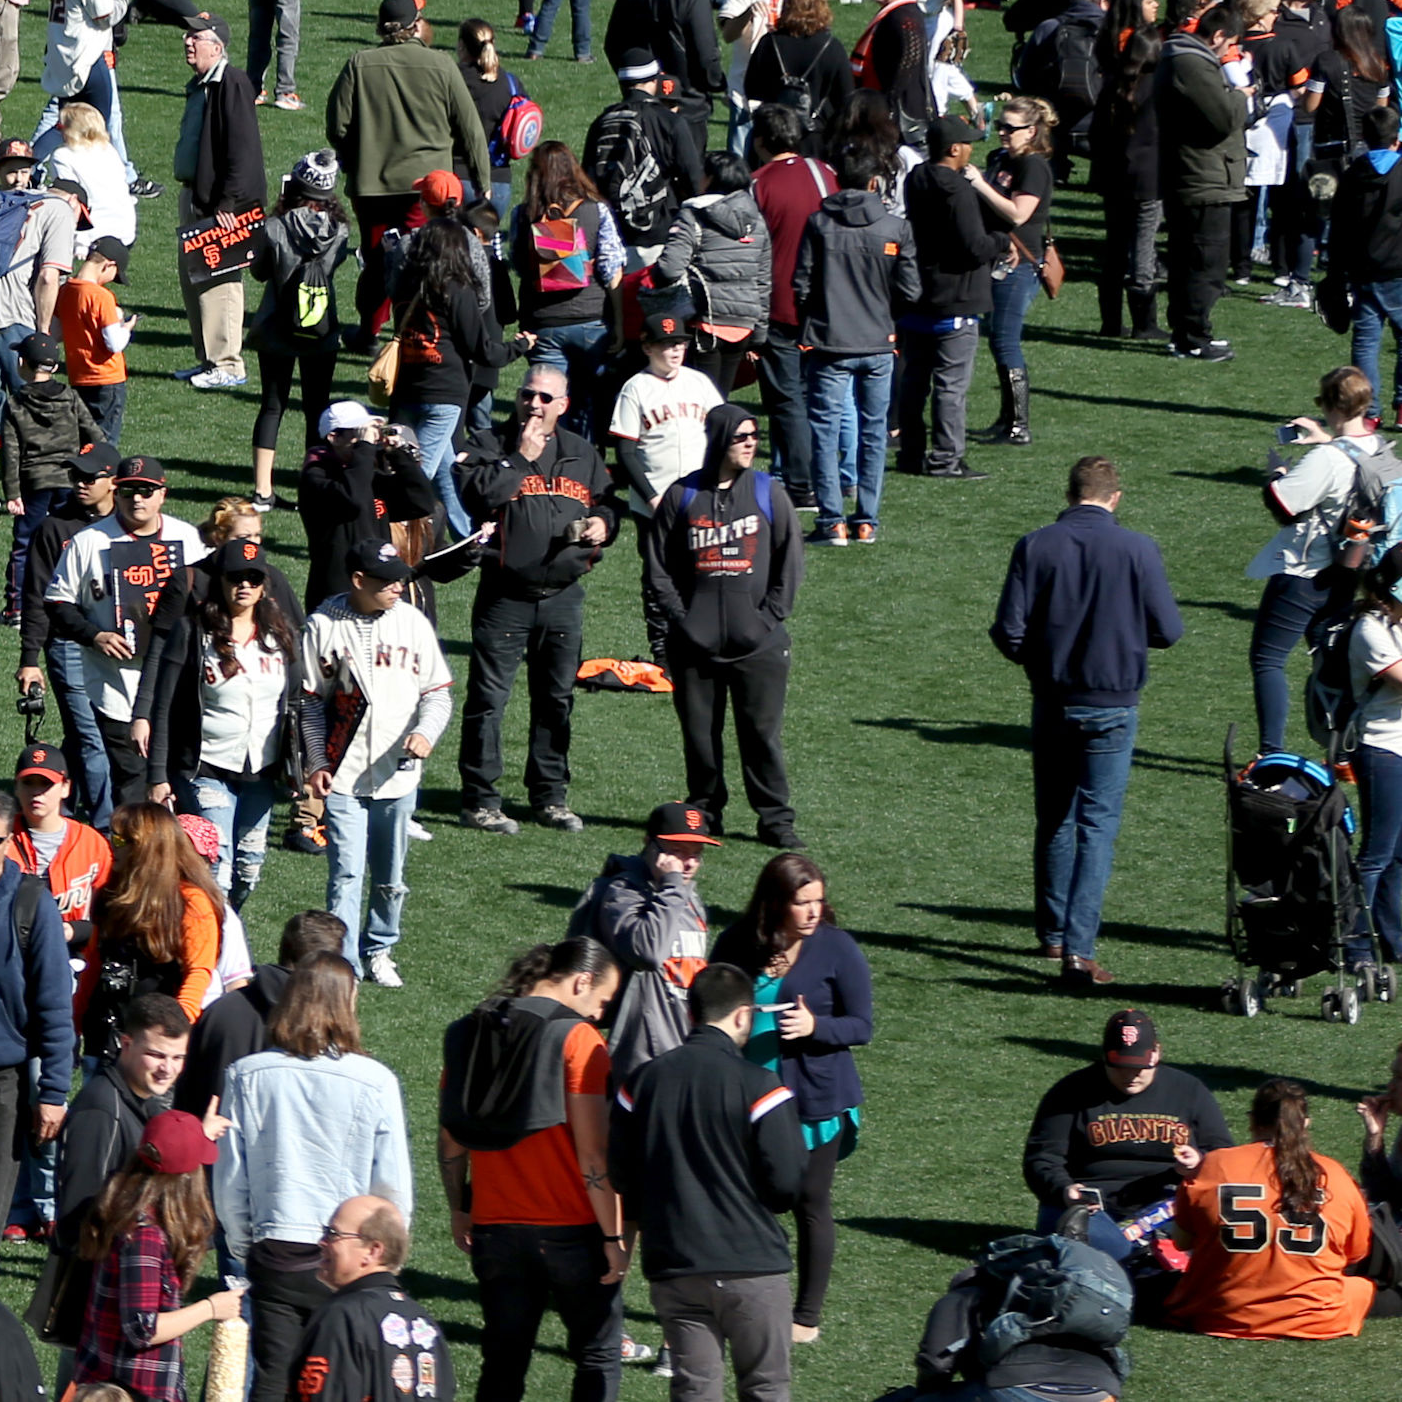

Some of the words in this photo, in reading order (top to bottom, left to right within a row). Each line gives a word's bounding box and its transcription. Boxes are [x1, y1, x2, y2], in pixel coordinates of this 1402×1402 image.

[183, 207, 264, 254] AUTHTIC
[220, 228, 251, 249] FAN
[203, 244, 221, 270] SF
[689, 513, 760, 552] GIANTS
[1086, 1119, 1190, 1148] GIANTS
